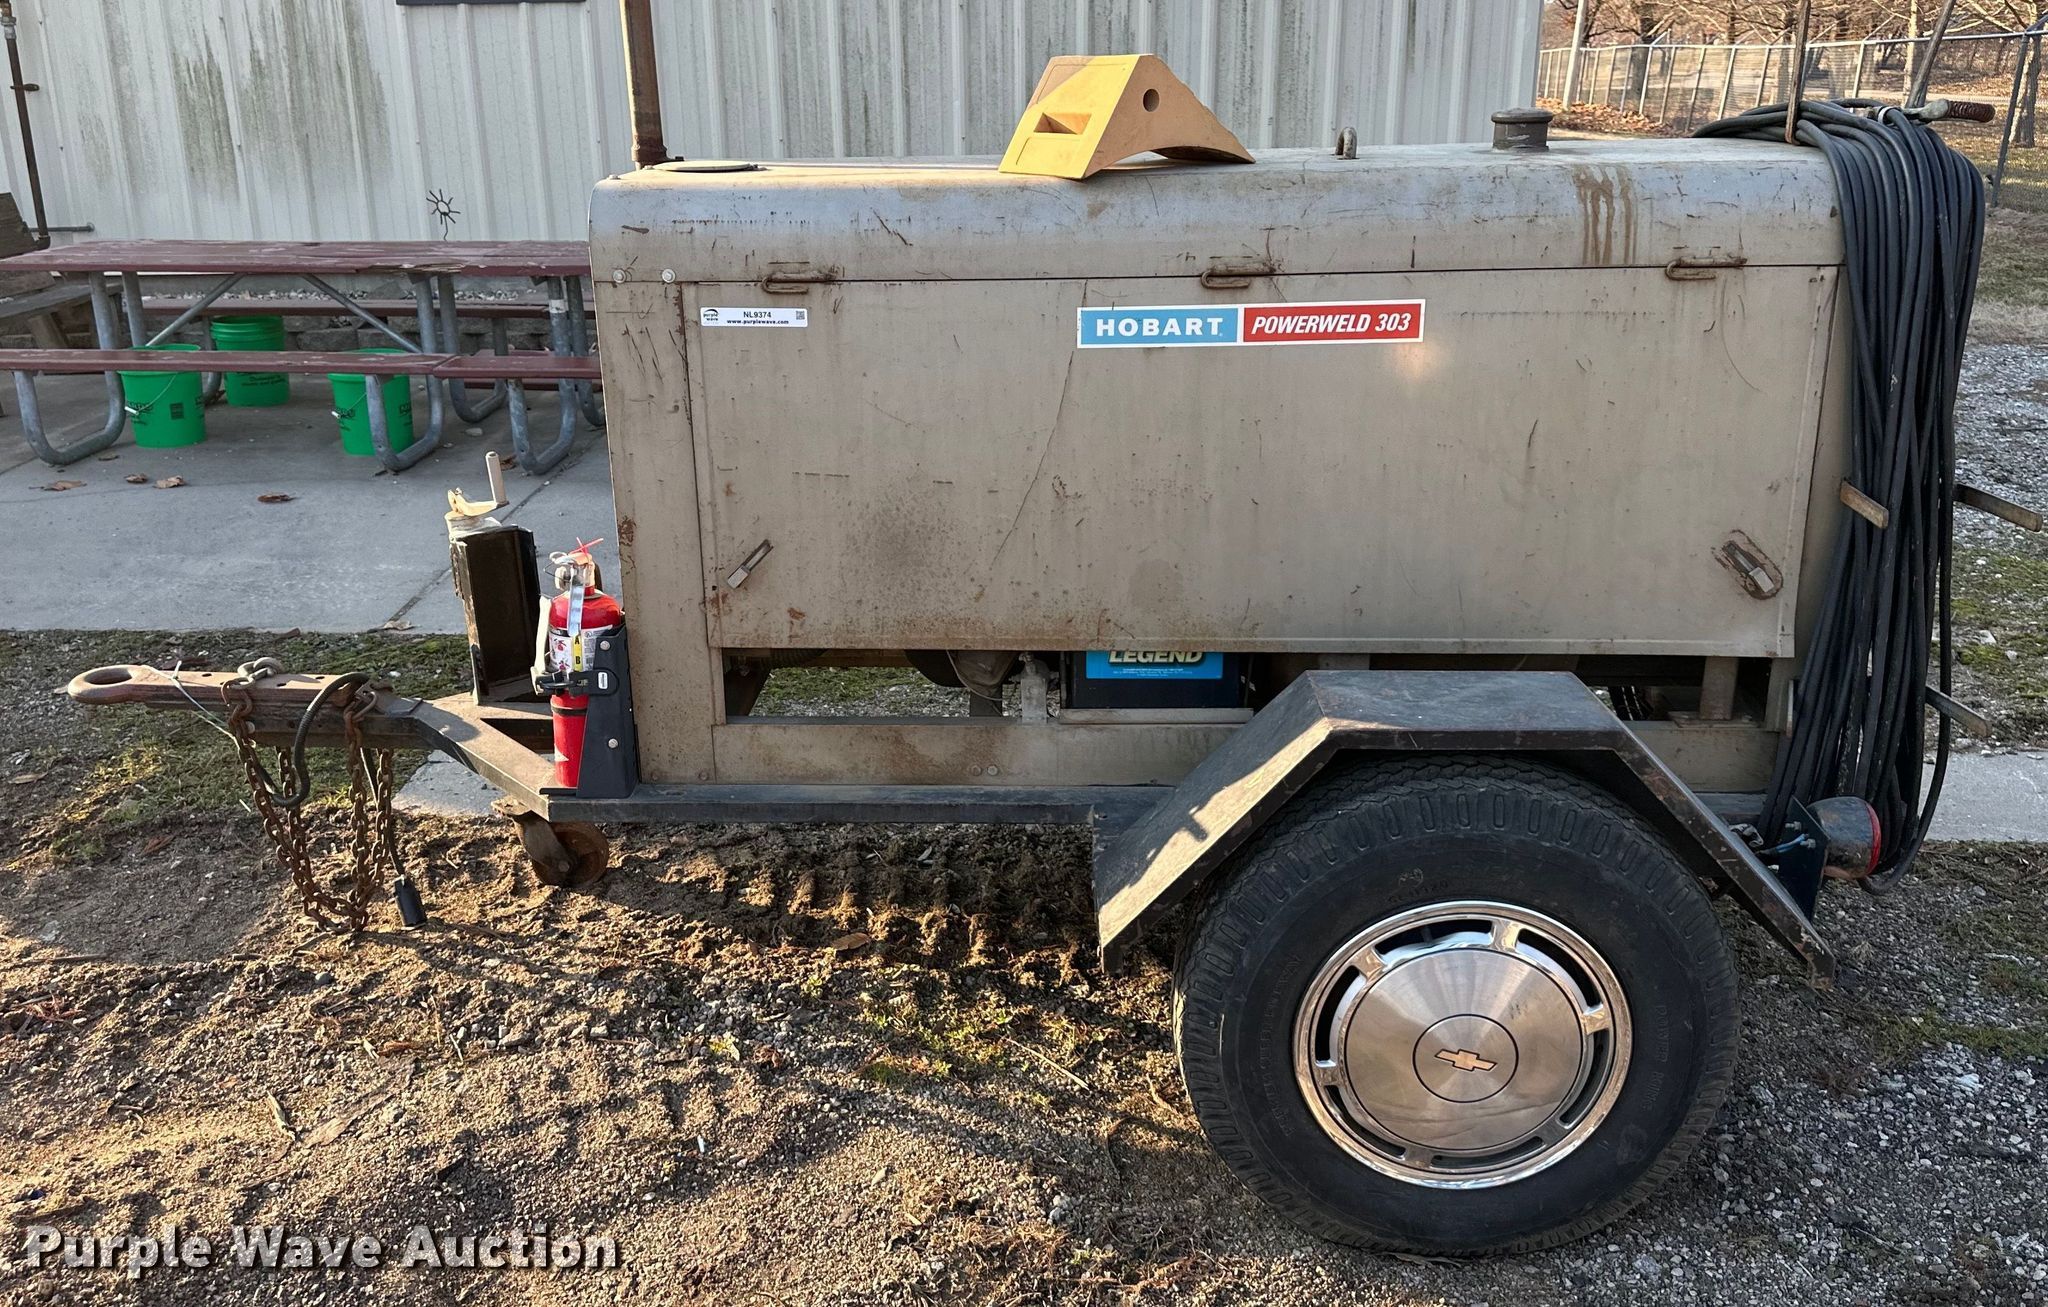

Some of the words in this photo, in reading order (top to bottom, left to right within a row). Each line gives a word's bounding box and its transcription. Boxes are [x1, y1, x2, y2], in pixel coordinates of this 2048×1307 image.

[743, 311, 772, 319] NL9374
[1096, 316, 1224, 338] HOBART
[1250, 313, 1371, 337] POWERWELD
[1374, 312, 1412, 333] 303
[575, 635, 580, 644] A
[576, 656, 581, 664] B
[1109, 650, 1203, 663] LEGEND
